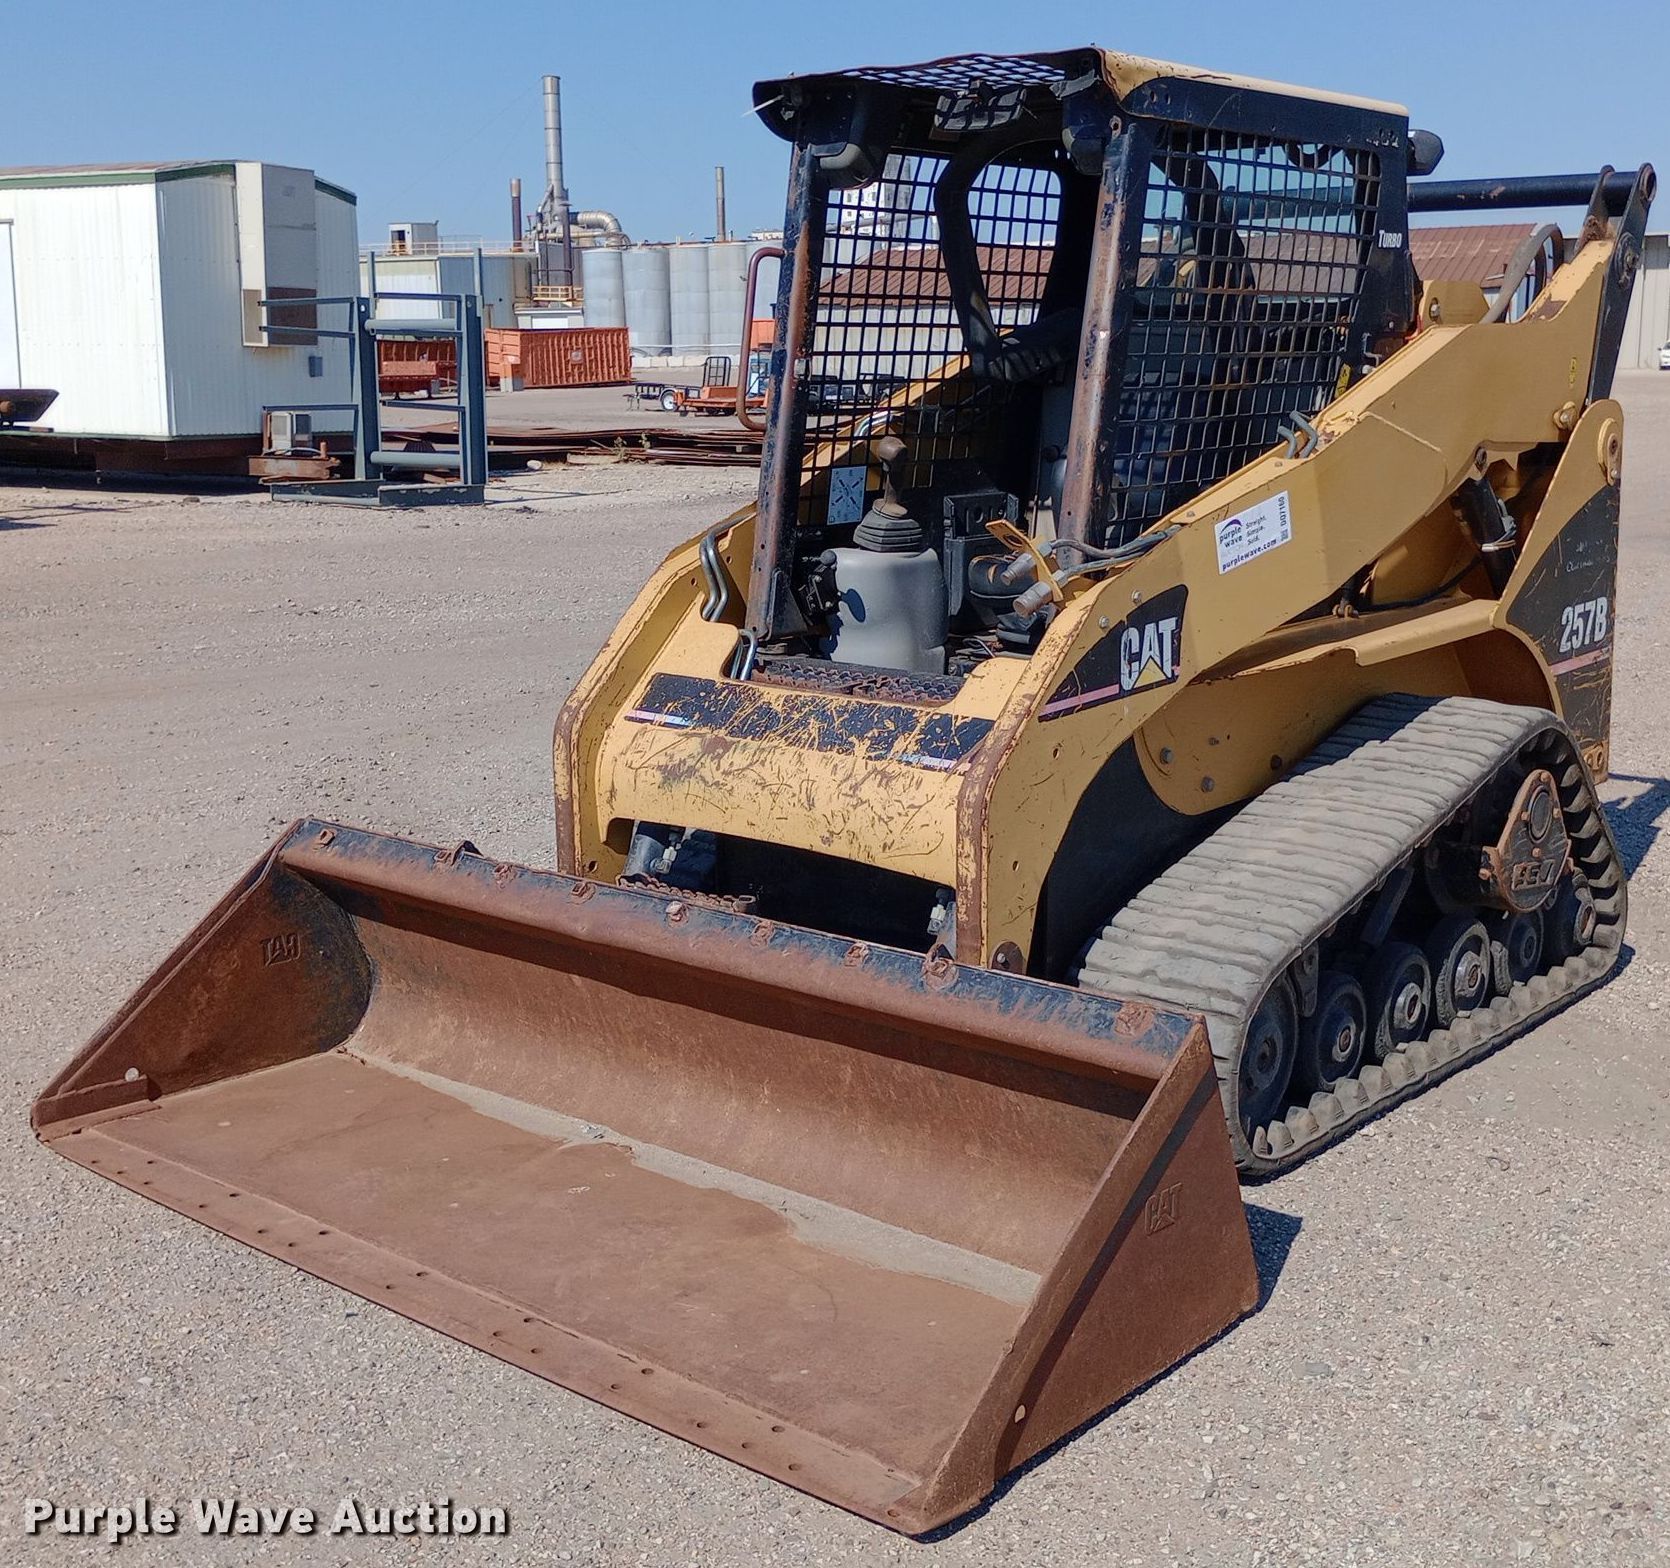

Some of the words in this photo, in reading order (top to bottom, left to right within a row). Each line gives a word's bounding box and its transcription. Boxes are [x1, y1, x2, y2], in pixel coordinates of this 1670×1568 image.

[1219, 526, 1242, 545] purple
[1222, 538, 1277, 572] purplewave.com
[1224, 535, 1243, 548] wave
[1559, 596, 1608, 653] 257B
[1120, 616, 1178, 691] CAT
[1144, 1181, 1183, 1236] CAT
